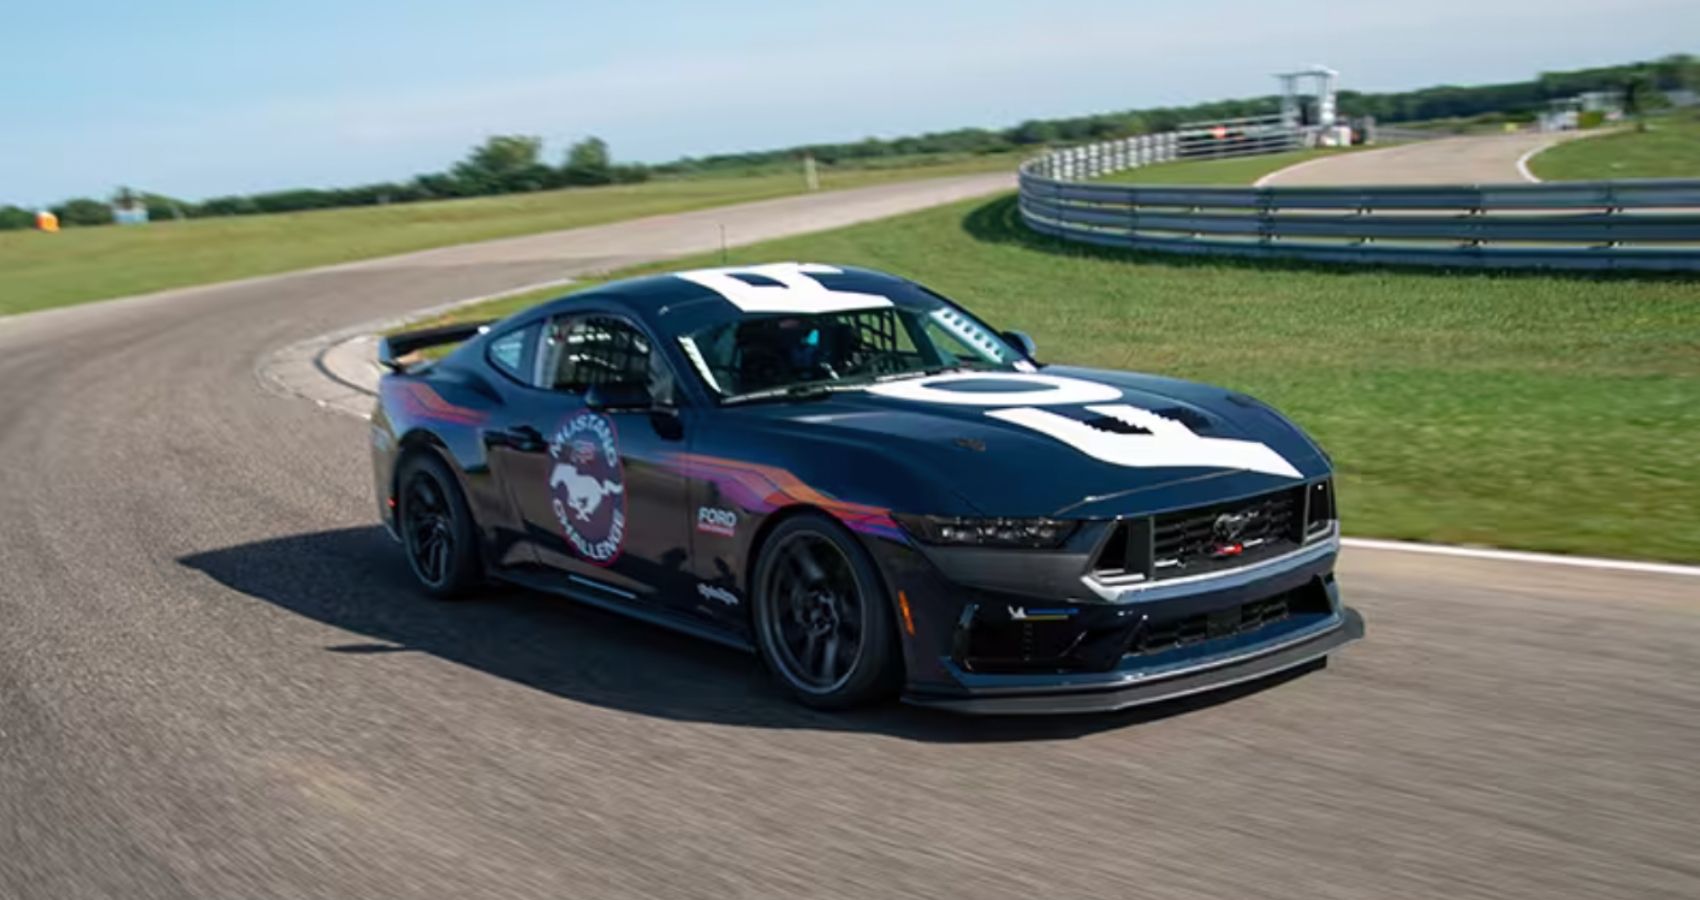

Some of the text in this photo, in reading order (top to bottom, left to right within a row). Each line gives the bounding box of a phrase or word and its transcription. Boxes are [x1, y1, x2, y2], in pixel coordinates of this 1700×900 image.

[549, 413, 618, 468] MUSTANG
[552, 497, 625, 561] CHALLENGE
[698, 506, 737, 528] FORD
